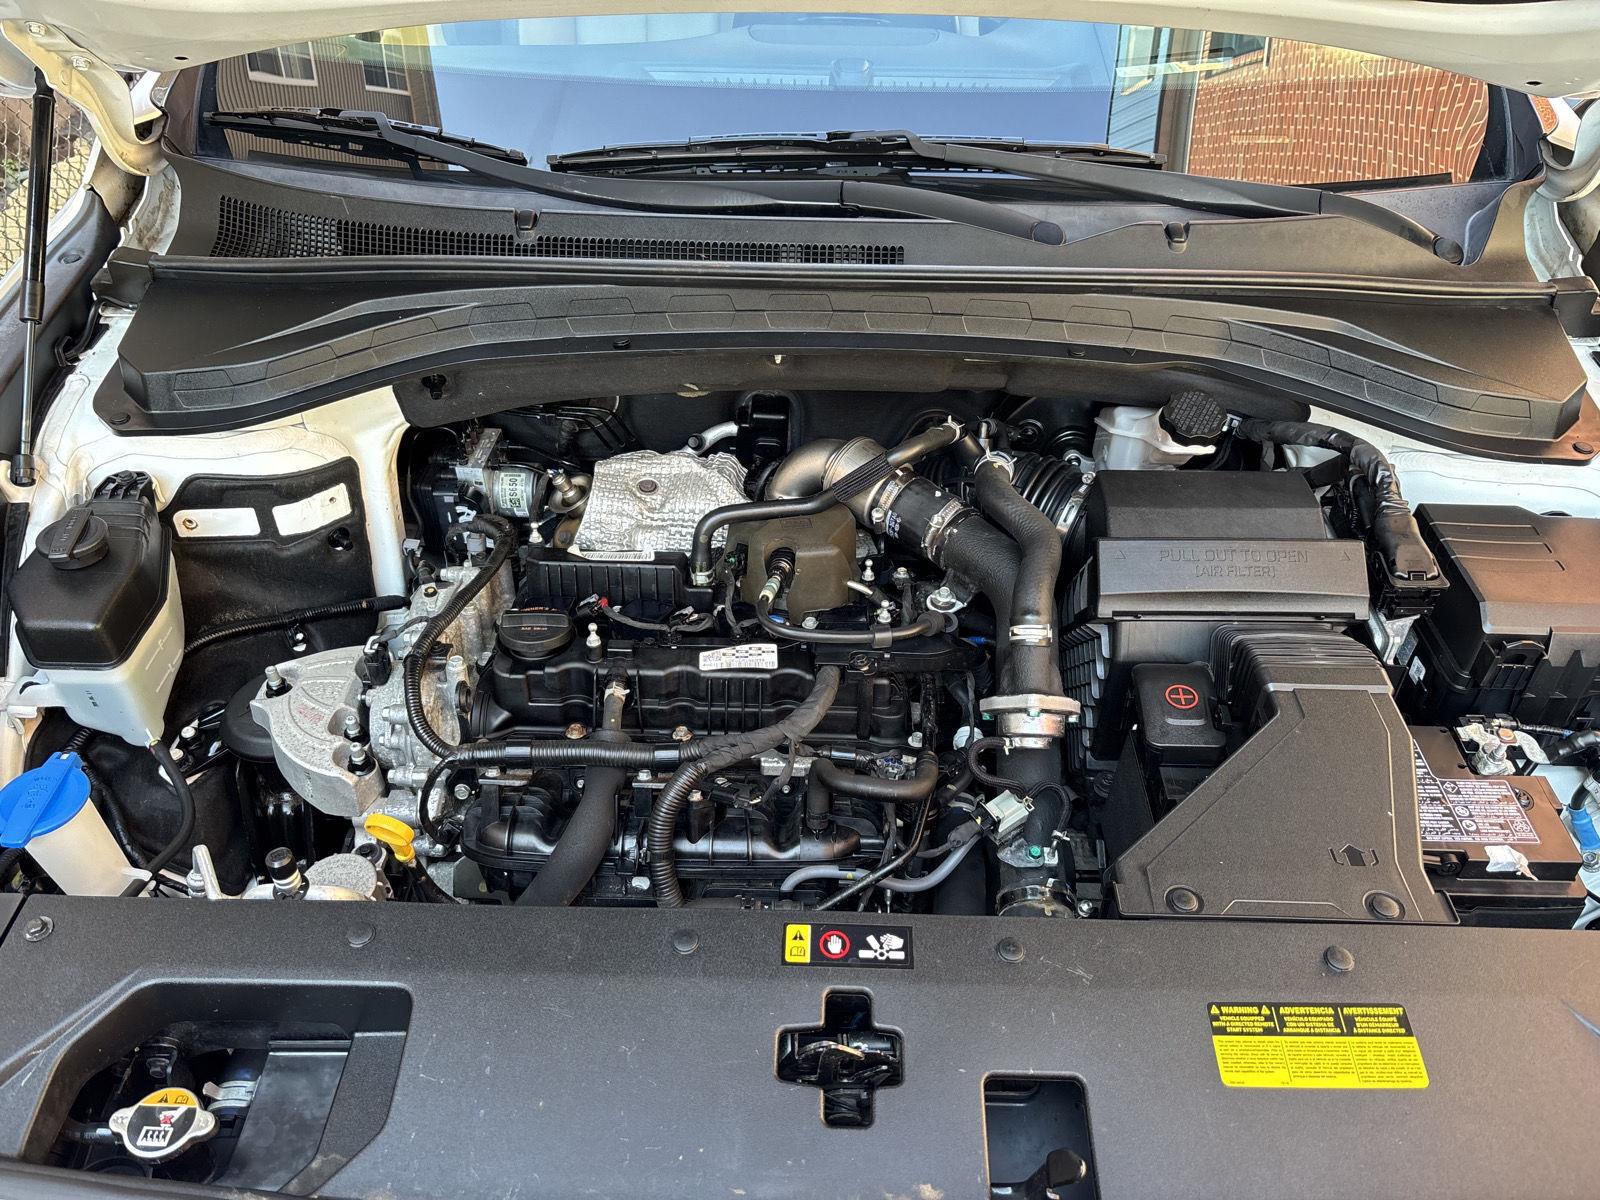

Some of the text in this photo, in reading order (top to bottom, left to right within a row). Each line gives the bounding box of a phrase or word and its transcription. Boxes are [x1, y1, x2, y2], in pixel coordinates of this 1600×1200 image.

[1160, 549, 1308, 563] PULL OUT TO OPEN
[1220, 1006, 1259, 1014] WARNING
[1280, 1006, 1334, 1014] ADVERTENCIA
[1343, 1006, 1404, 1015] AVERTISSEMENT
